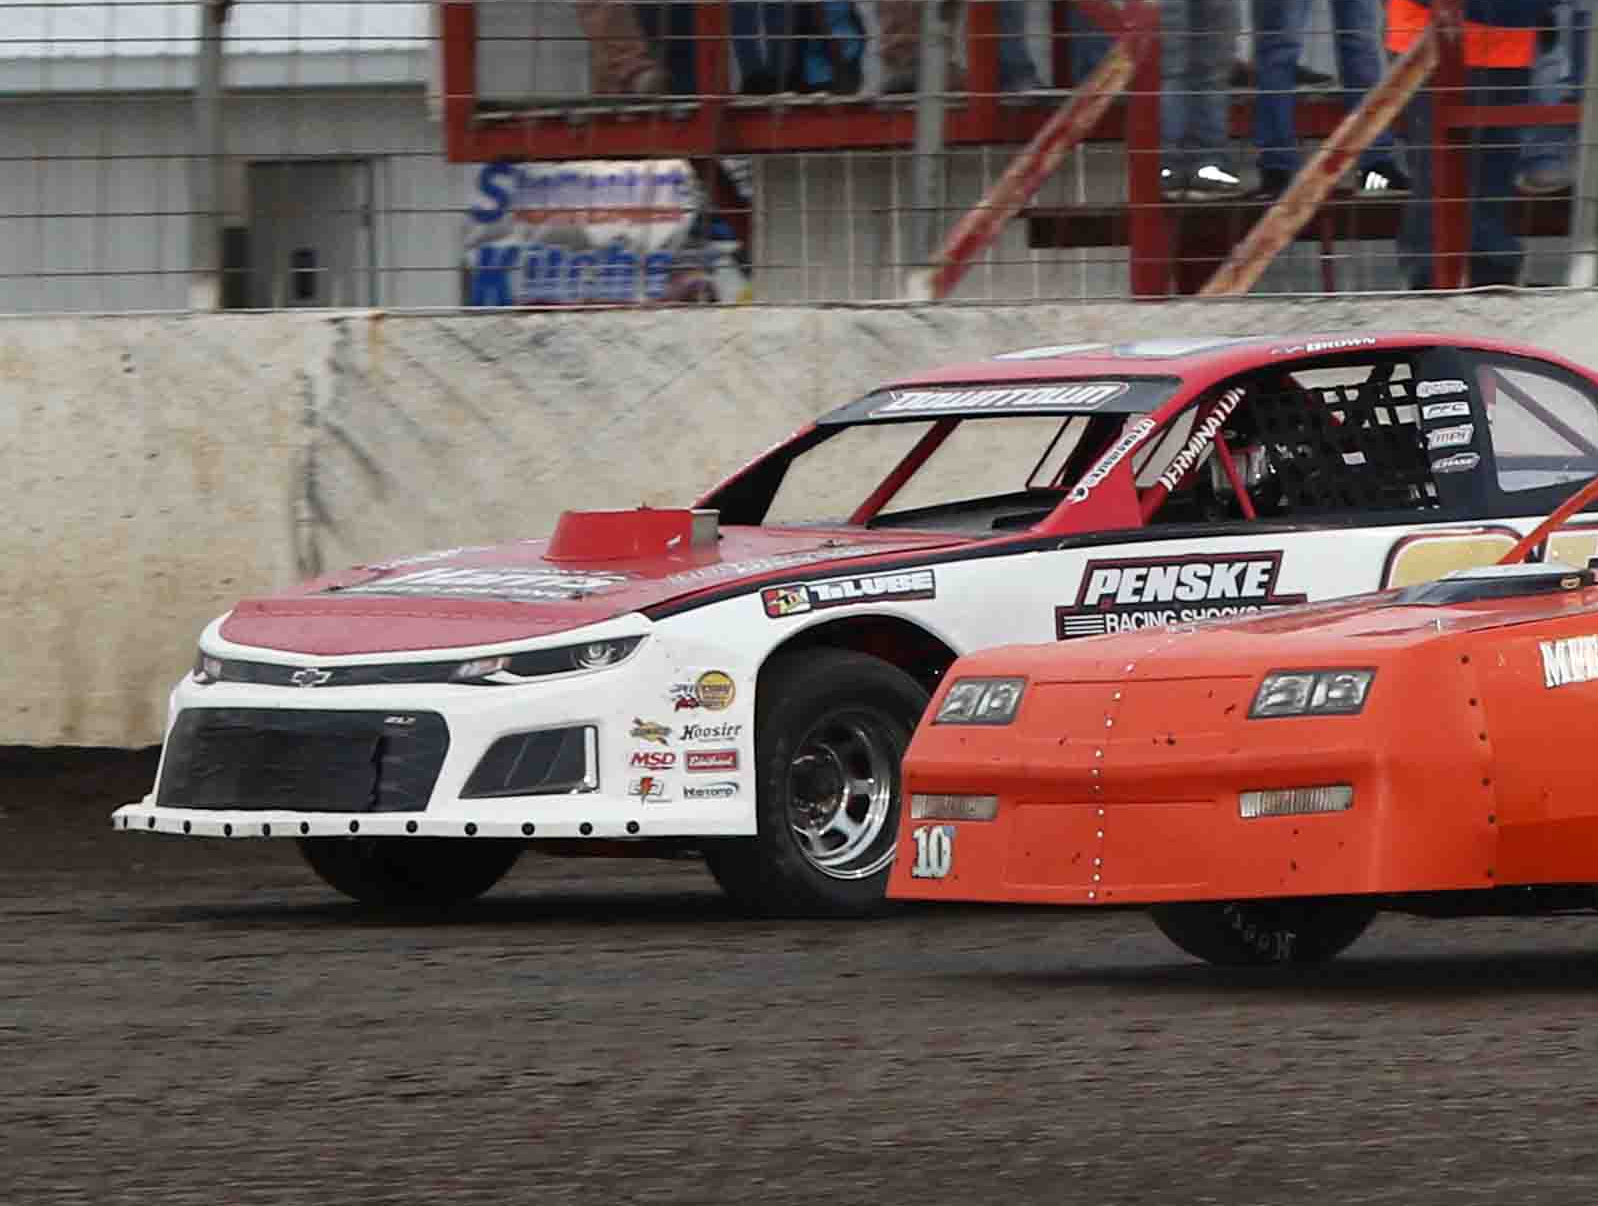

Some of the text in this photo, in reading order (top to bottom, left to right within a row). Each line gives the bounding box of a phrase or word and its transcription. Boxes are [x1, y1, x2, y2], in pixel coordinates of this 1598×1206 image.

[1082, 560, 1275, 606] PENSKE
[1103, 605, 1260, 635] RACING SHOC
[679, 722, 742, 742] Hoosier
[631, 750, 677, 770] MSD
[910, 824, 953, 879] 10
